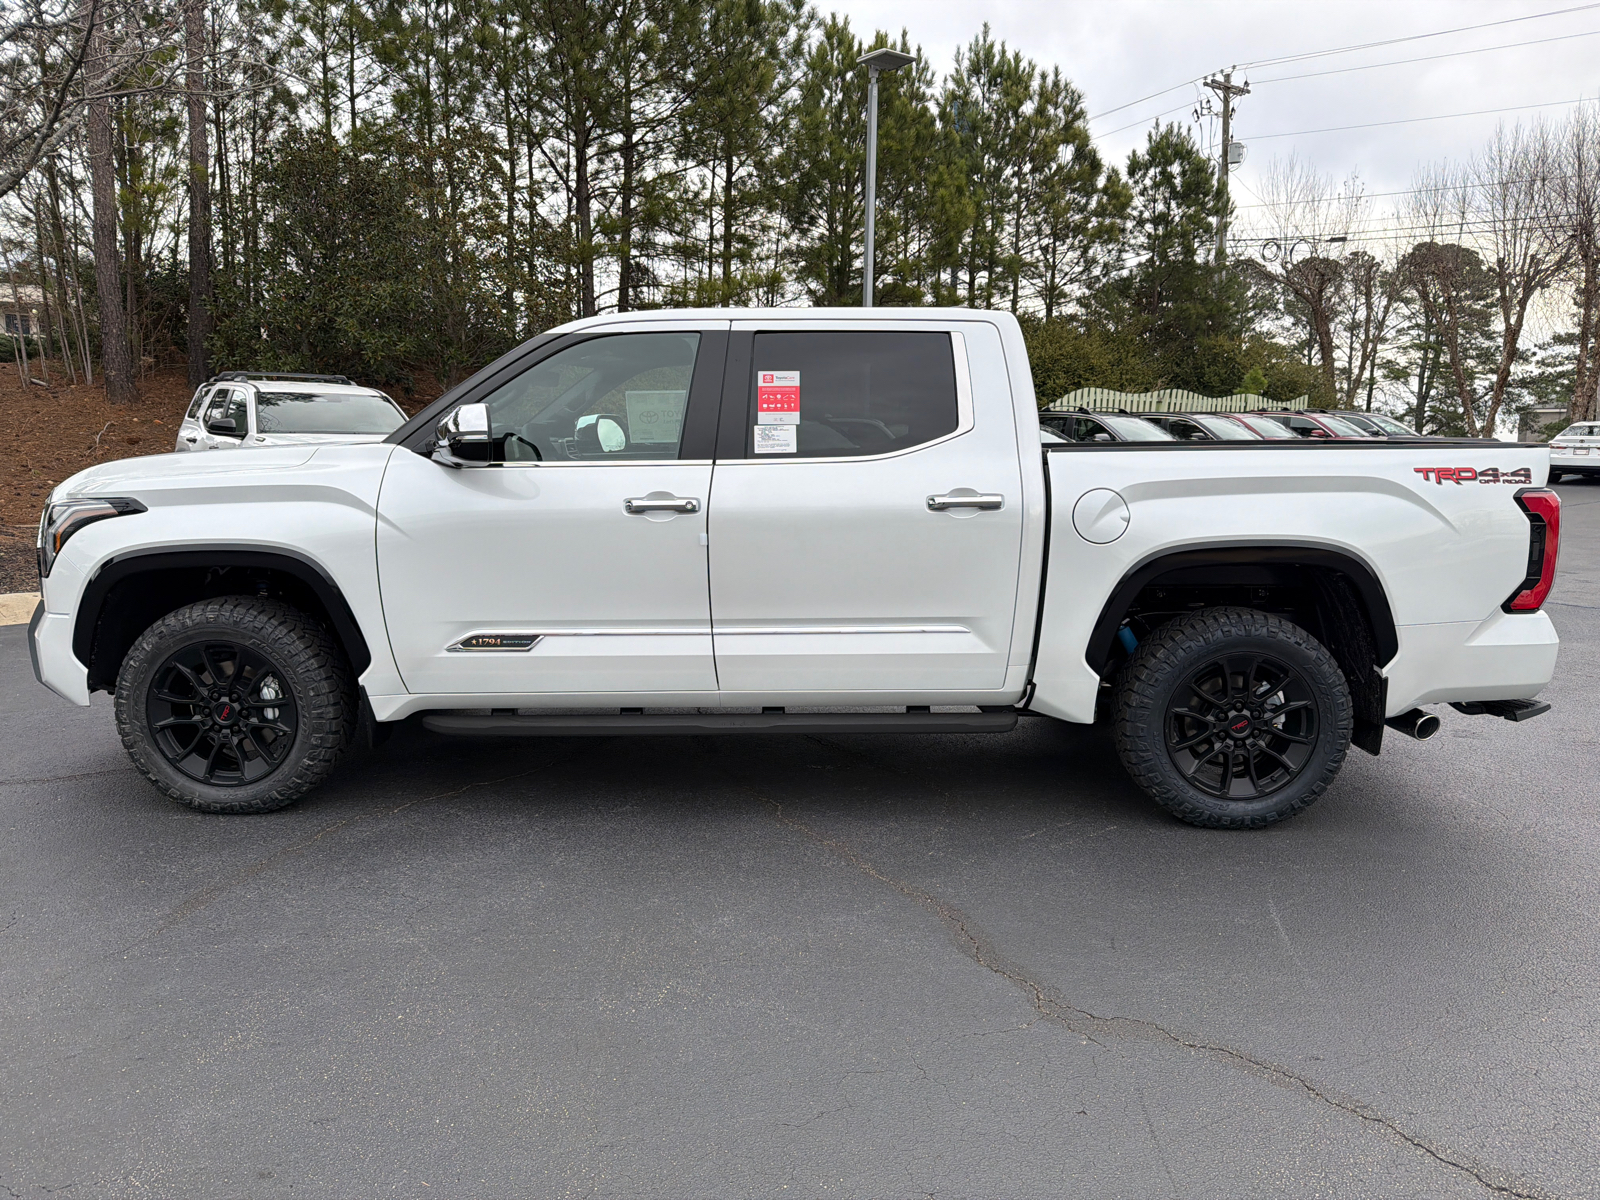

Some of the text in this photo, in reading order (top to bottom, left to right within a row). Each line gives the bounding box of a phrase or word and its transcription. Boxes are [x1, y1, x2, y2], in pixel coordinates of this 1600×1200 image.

[1413, 467, 1478, 485] TRD
[478, 638, 501, 646] 1794
[1231, 719, 1249, 730] TRD
